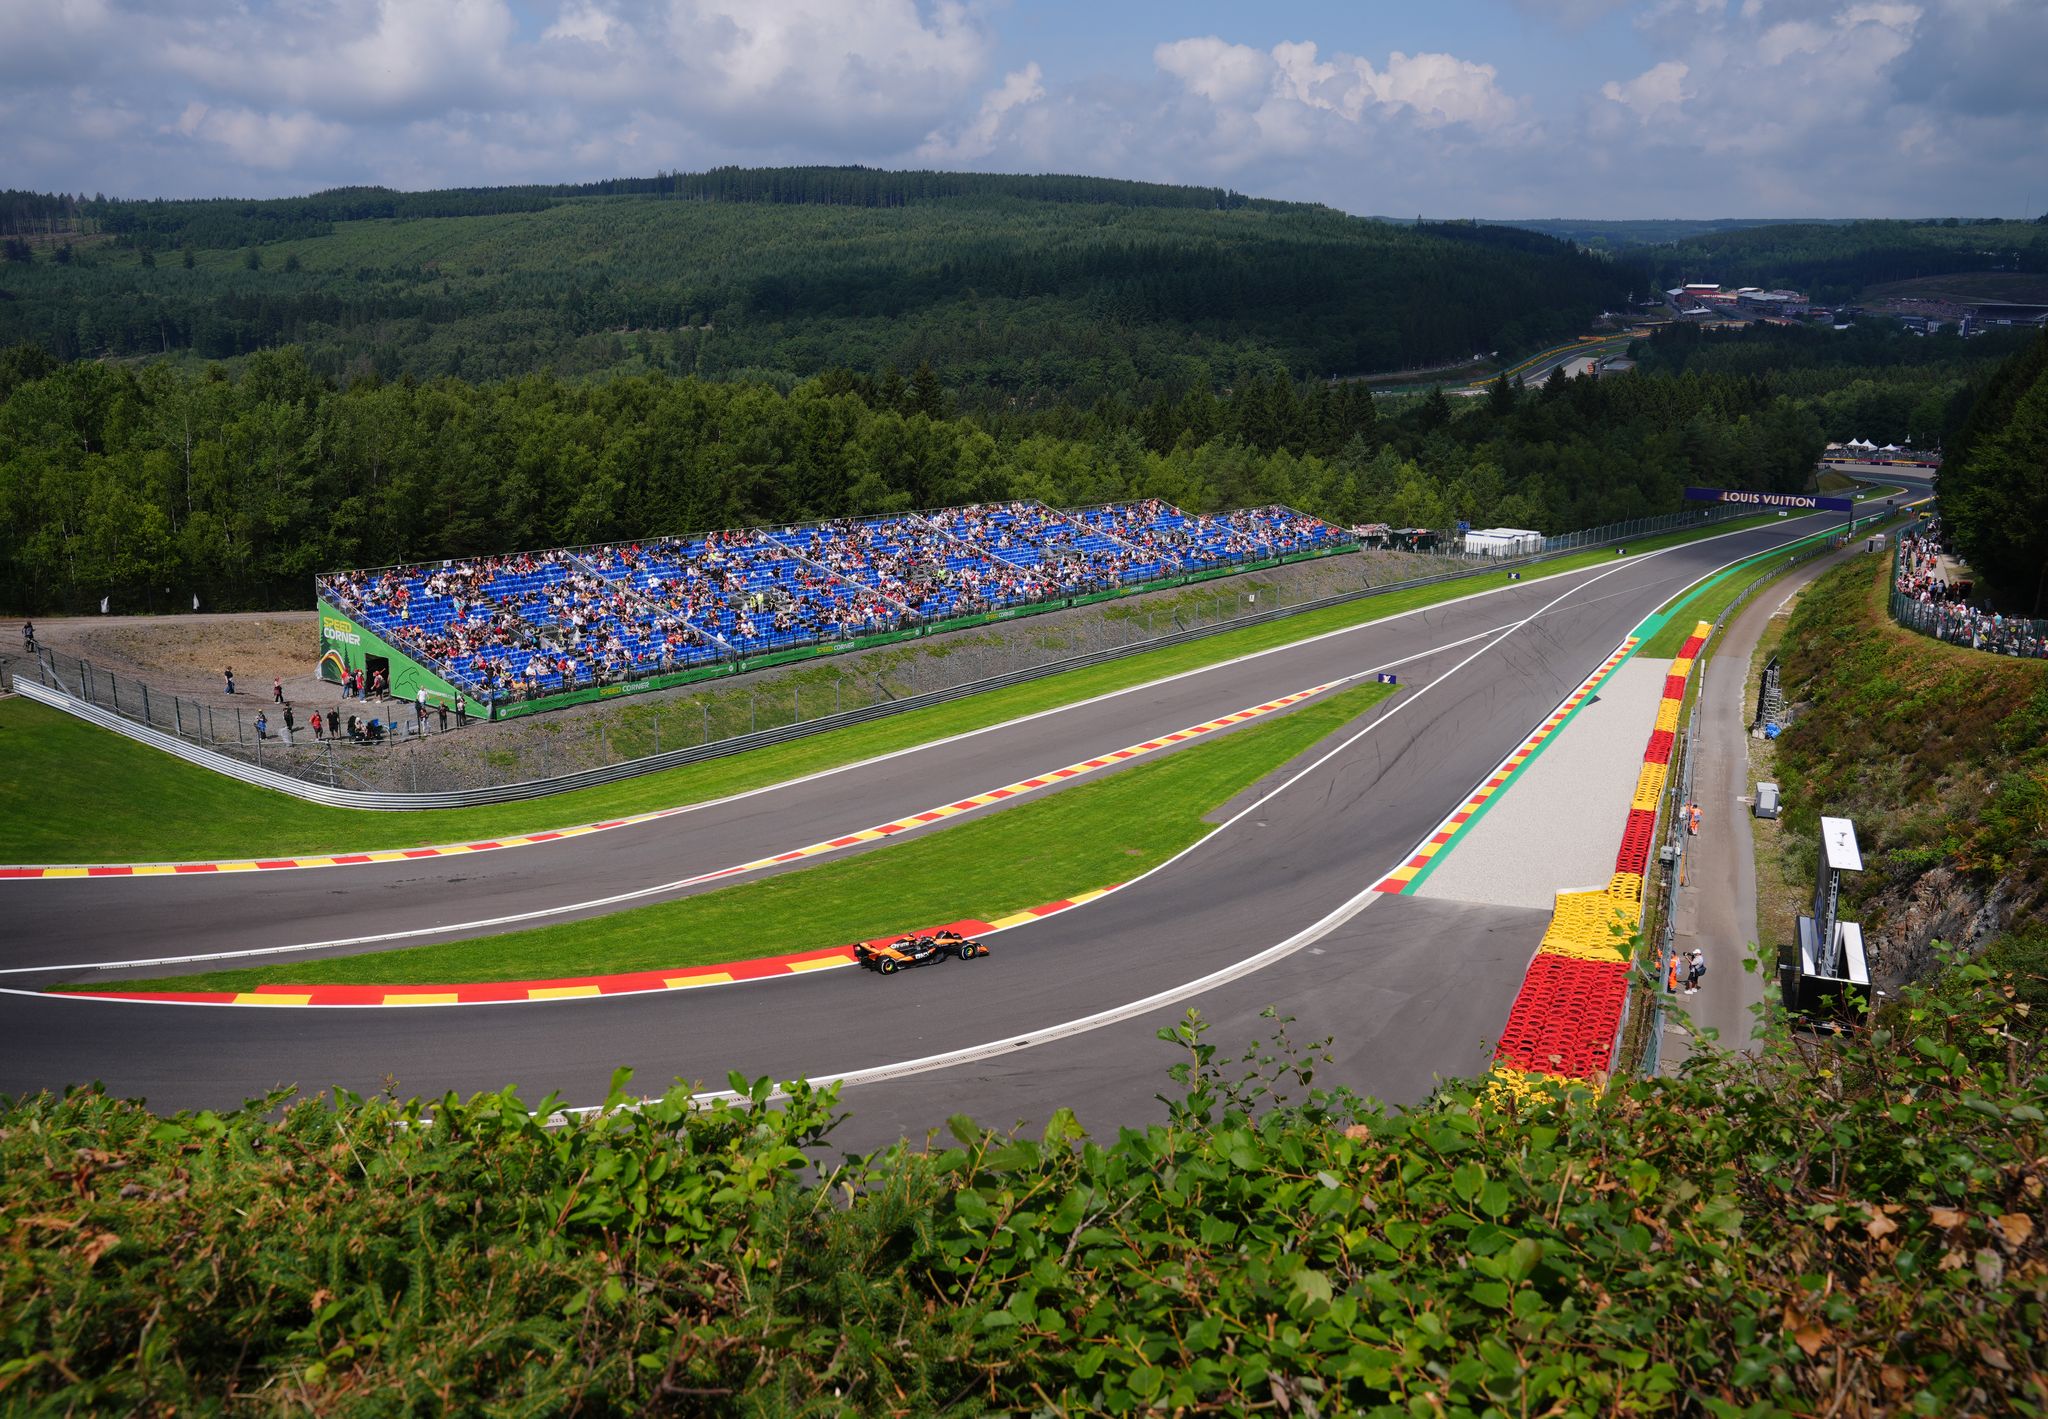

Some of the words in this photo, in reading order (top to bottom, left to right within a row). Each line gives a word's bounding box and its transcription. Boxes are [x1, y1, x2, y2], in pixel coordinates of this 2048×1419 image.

[1723, 491, 1760, 504] LOUIS
[1763, 494, 1816, 508] VUITTON
[323, 616, 352, 633] SPEED
[323, 627, 360, 646] CORNER
[833, 641, 855, 651] CORNER
[600, 686, 621, 695] SPEED
[622, 682, 649, 692] CORNER
